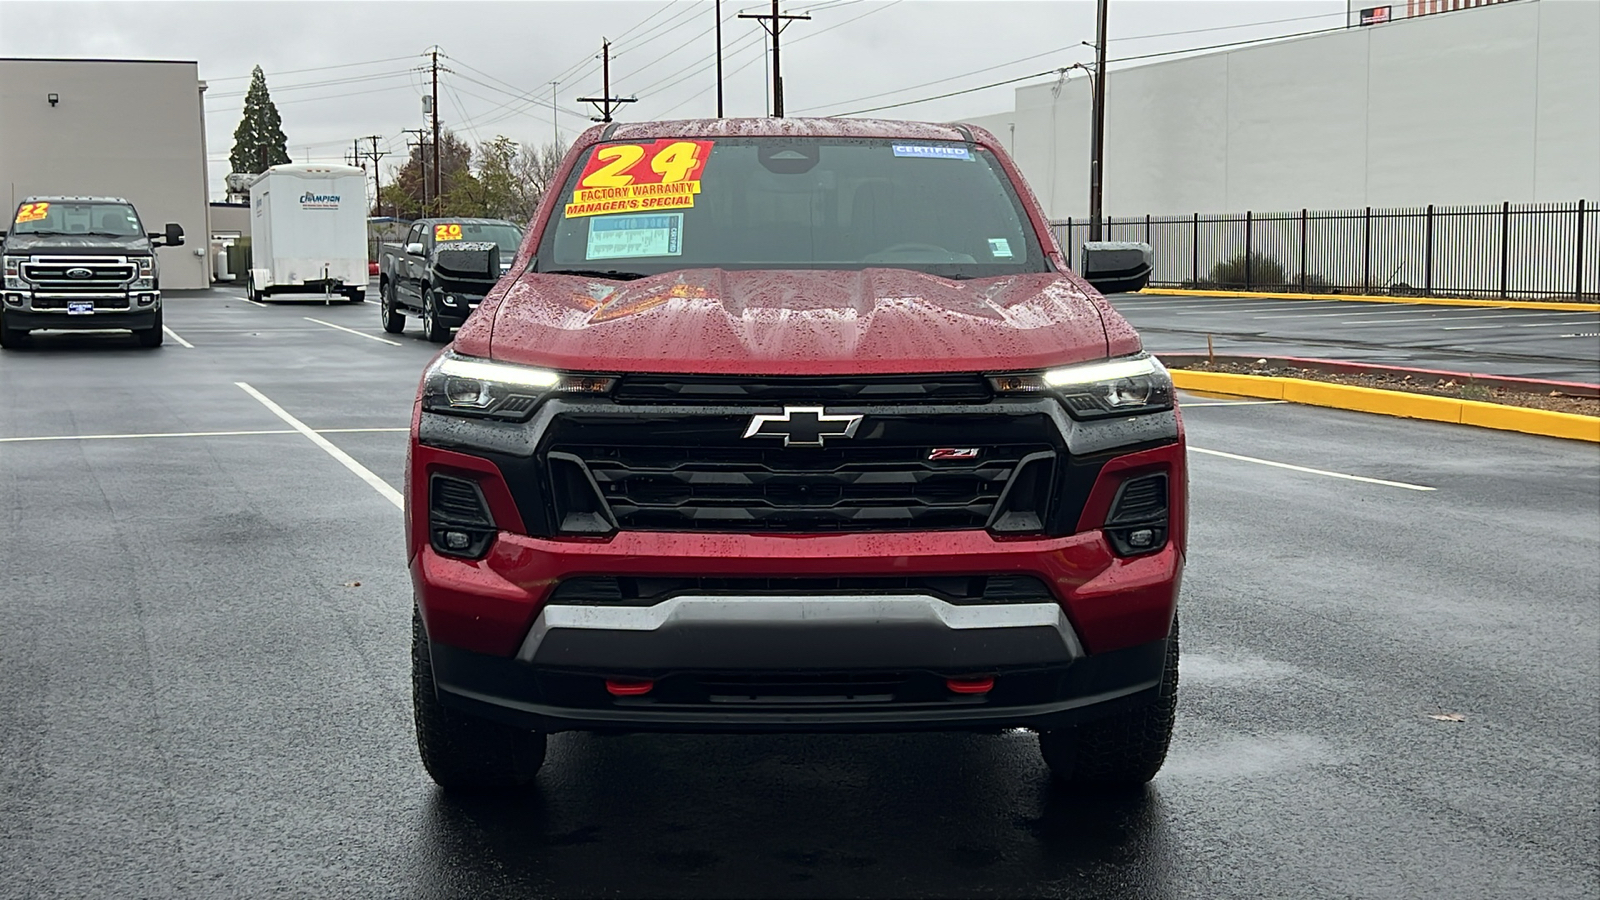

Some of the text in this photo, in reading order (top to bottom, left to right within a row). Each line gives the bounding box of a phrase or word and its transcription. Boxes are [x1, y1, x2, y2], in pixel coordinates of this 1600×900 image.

[896, 146, 965, 155] CERTIFIED
[582, 142, 700, 187] 24
[581, 182, 695, 201] FACTORY WARRANTY
[18, 202, 48, 215] 22
[566, 195, 692, 215] MANAGER'S SPECIAL
[436, 224, 460, 235] 20
